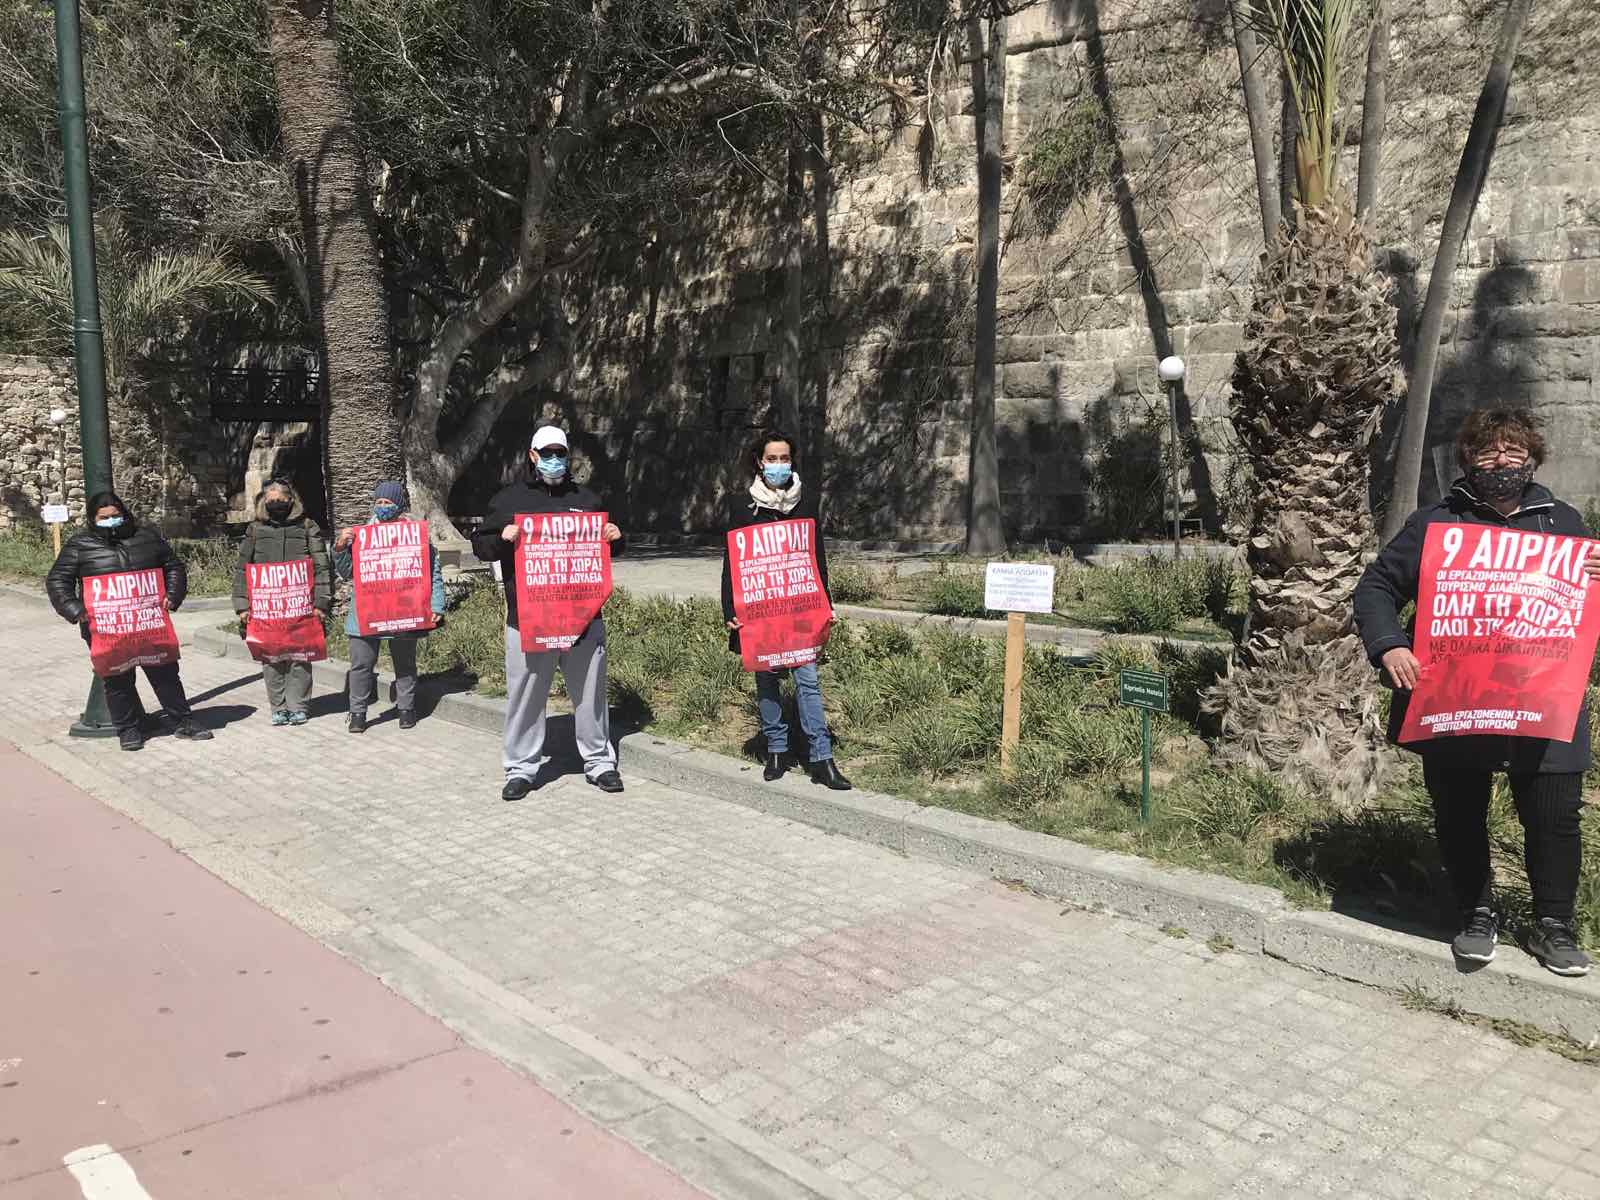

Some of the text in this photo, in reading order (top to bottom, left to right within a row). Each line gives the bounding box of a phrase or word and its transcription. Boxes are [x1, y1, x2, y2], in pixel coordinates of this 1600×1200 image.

[359, 523, 421, 550] 9 ΑΠΡΙΛΗ
[523, 515, 602, 543] 9 ΑΠΡΙΛΗ
[736, 522, 810, 560] 9 ΑΠΡΙΛΗ
[1442, 527, 1464, 569] 9
[250, 561, 309, 588] 9 ΑΠΡΙΛΗ
[525, 558, 603, 574] ΟΛΗ ΤΗ ΧΩΡΑ!
[1436, 571, 1446, 580] ΟΙ
[1449, 570, 1517, 582] ΕΡΓΑΖΟΜΕΝΟΙ
[92, 571, 159, 600] 9 ΑΠΡΙΛΗ
[526, 572, 602, 586] ΟΛΟΙ ΣΤΗ ΔΟΥΛΕΙΑ
[741, 574, 766, 591] ΟΛΗ
[768, 570, 785, 585] ΤΗ
[1436, 581, 1486, 593] ΤΟΥΡΙΣΜΟ
[743, 583, 819, 604] ΟΛΟΙ ΣΤΗ ΔΟΥΛΕΙΑ
[95, 612, 117, 625] ΟΛΗ
[118, 611, 134, 624] ΤΗ
[1432, 593, 1585, 627] ΟΛΗ ΤΗ ΧΩΡΑ!
[1430, 618, 1468, 637] ΟΛΟΙ
[1455, 709, 1514, 721] ΕΡΓΑΖΟΜΕΝΩΝ
[1516, 710, 1542, 722] ΣΤΟΝ
[1474, 720, 1518, 730] ΤΟΥΡΙΣΜΟ
